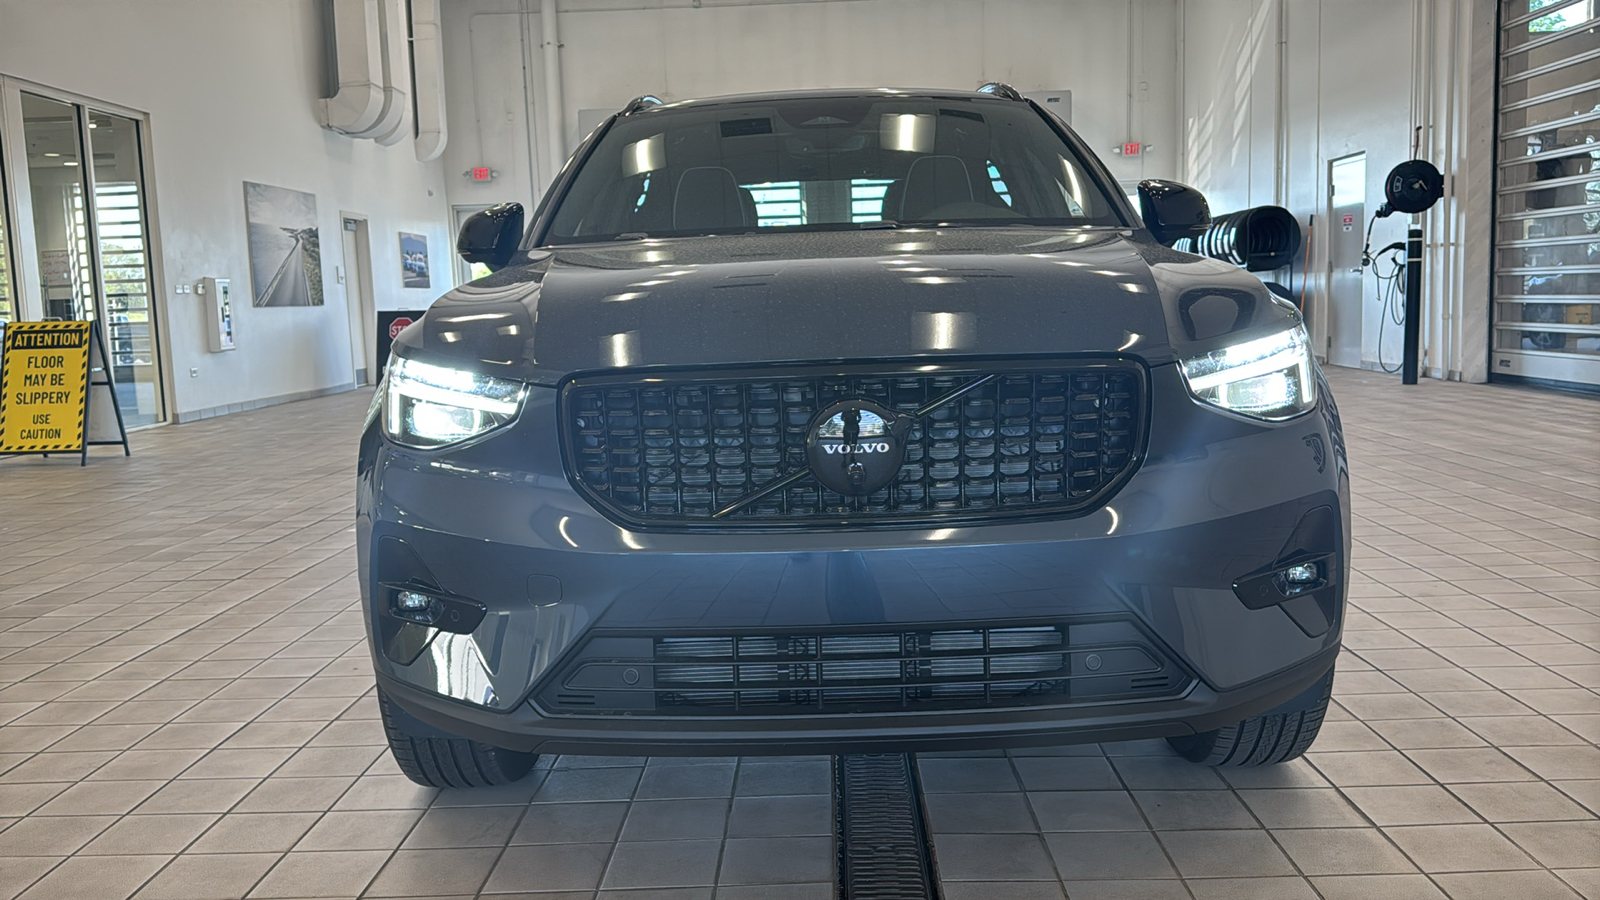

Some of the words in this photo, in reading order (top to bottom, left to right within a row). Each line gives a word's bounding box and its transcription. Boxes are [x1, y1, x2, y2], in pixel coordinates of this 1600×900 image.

[1124, 142, 1140, 155] EXIT
[473, 167, 488, 180] EXIT
[15, 332, 79, 346] ATTENTION
[27, 355, 64, 369] FLOOR
[23, 373, 47, 387] MAY
[50, 373, 65, 386] BE
[15, 391, 71, 405] SLIPPERY
[32, 414, 51, 425] USE
[20, 428, 61, 440] CAUTION
[822, 442, 890, 454] VOLVO
